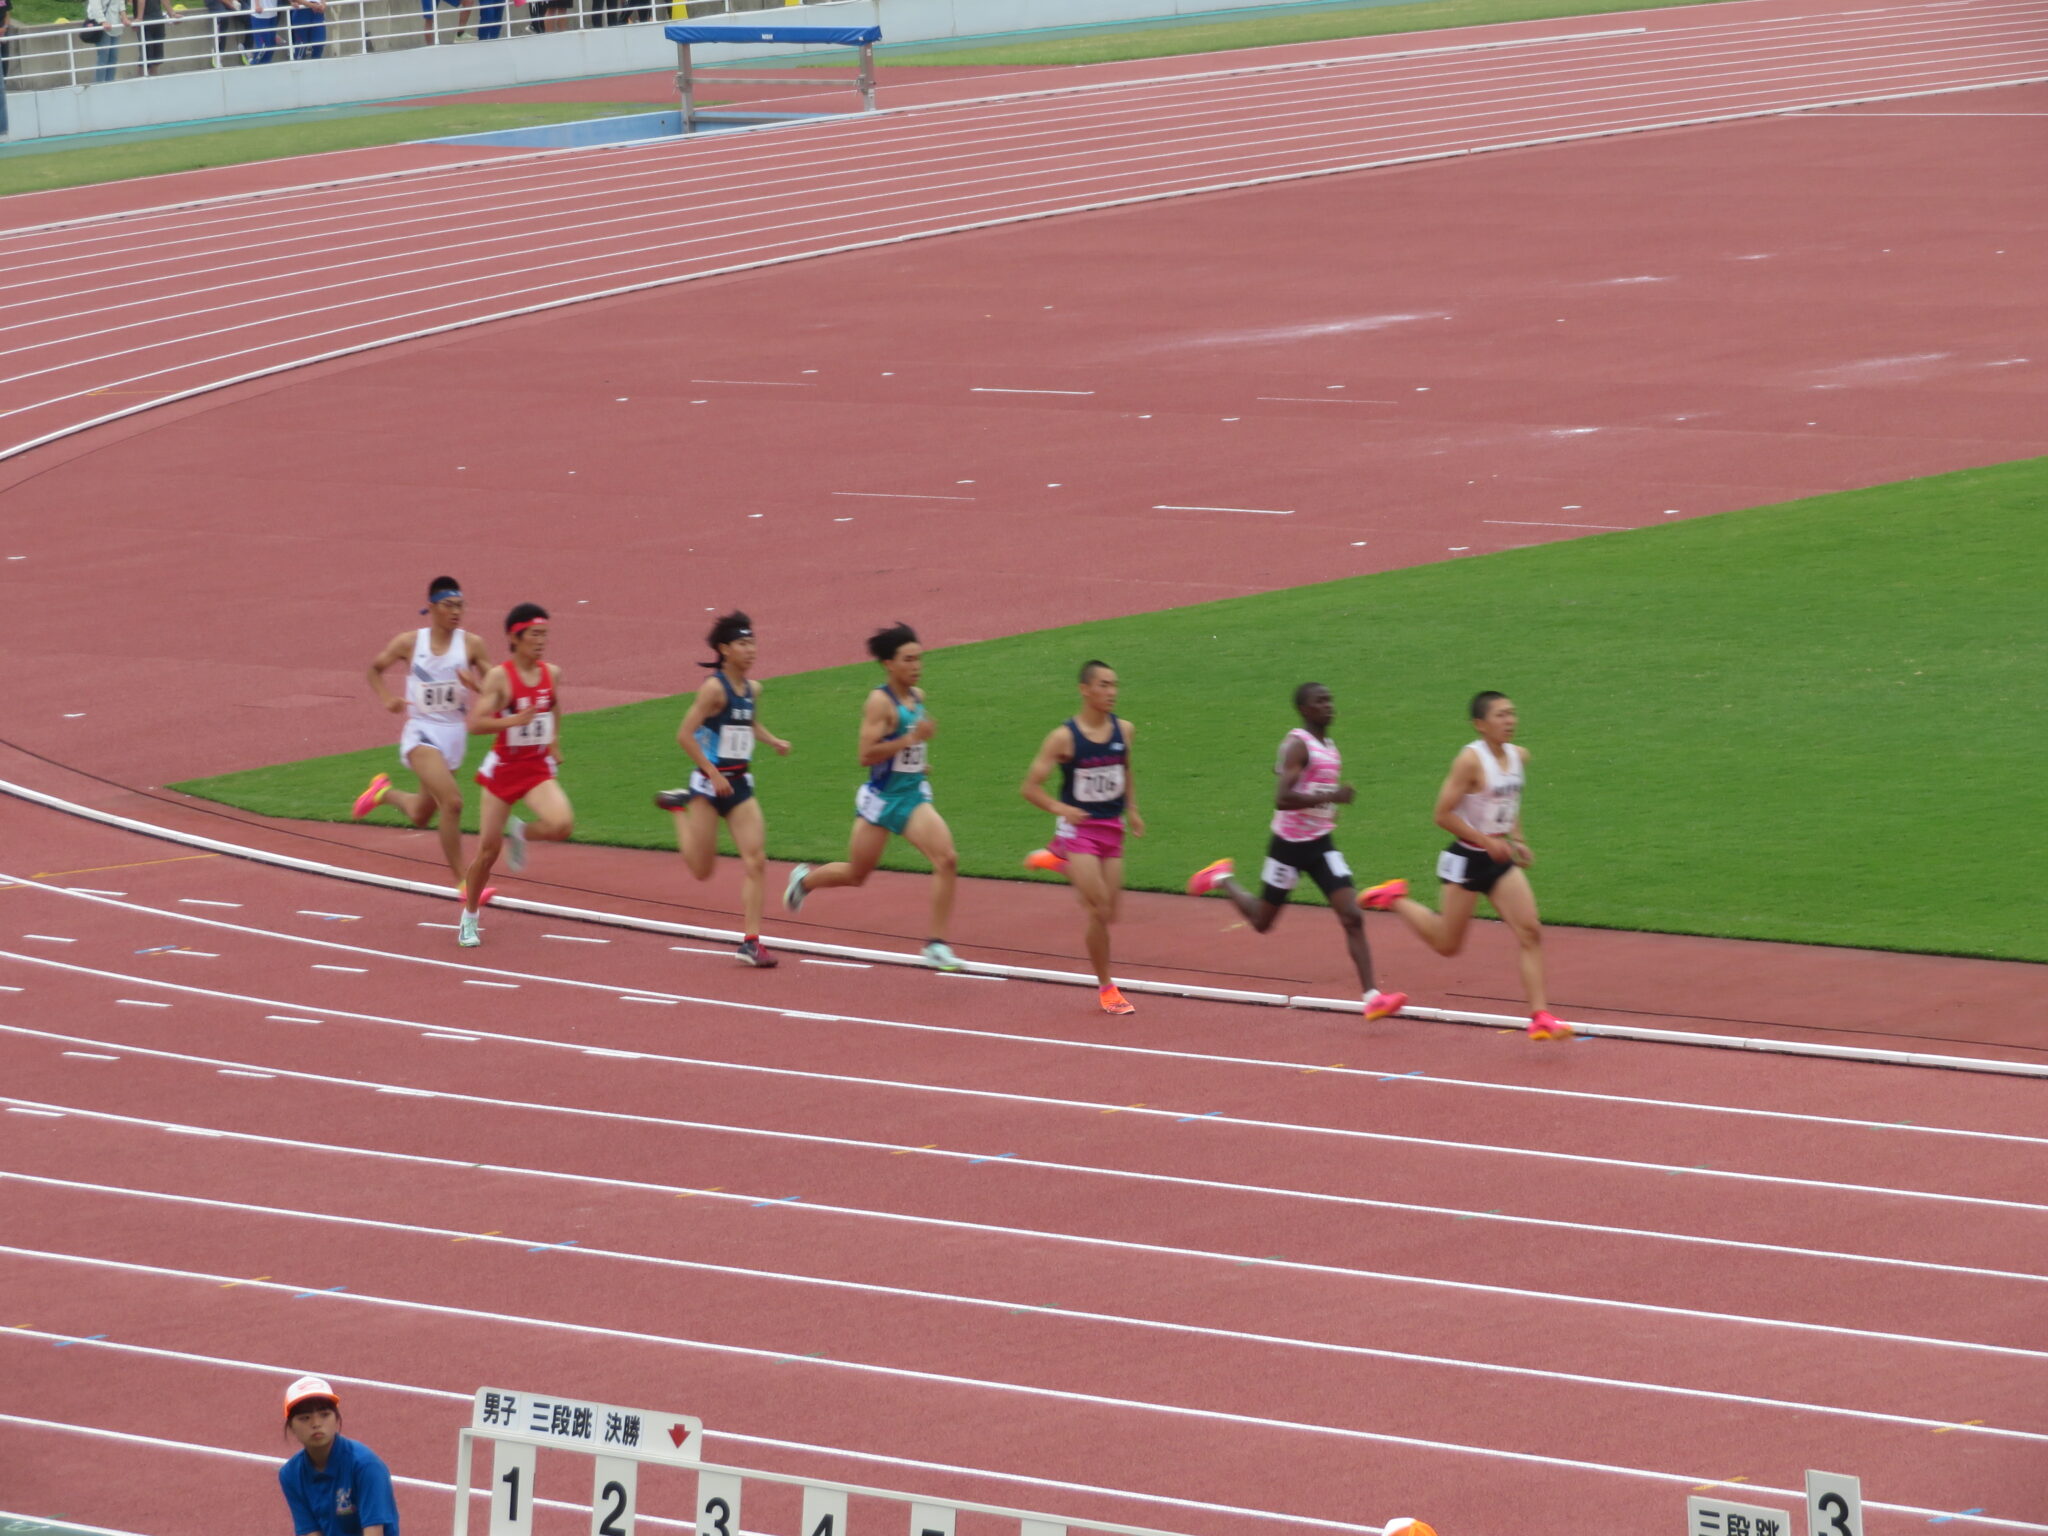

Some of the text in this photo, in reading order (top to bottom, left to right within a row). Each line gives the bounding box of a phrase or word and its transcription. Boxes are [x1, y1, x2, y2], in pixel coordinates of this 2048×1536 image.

[483, 1392, 641, 1447] 男子 三段跳 決勝
[502, 1466, 520, 1521] 1
[599, 1480, 627, 1536] 2
[703, 1497, 730, 1536] 3
[1818, 1492, 1853, 1536] 3
